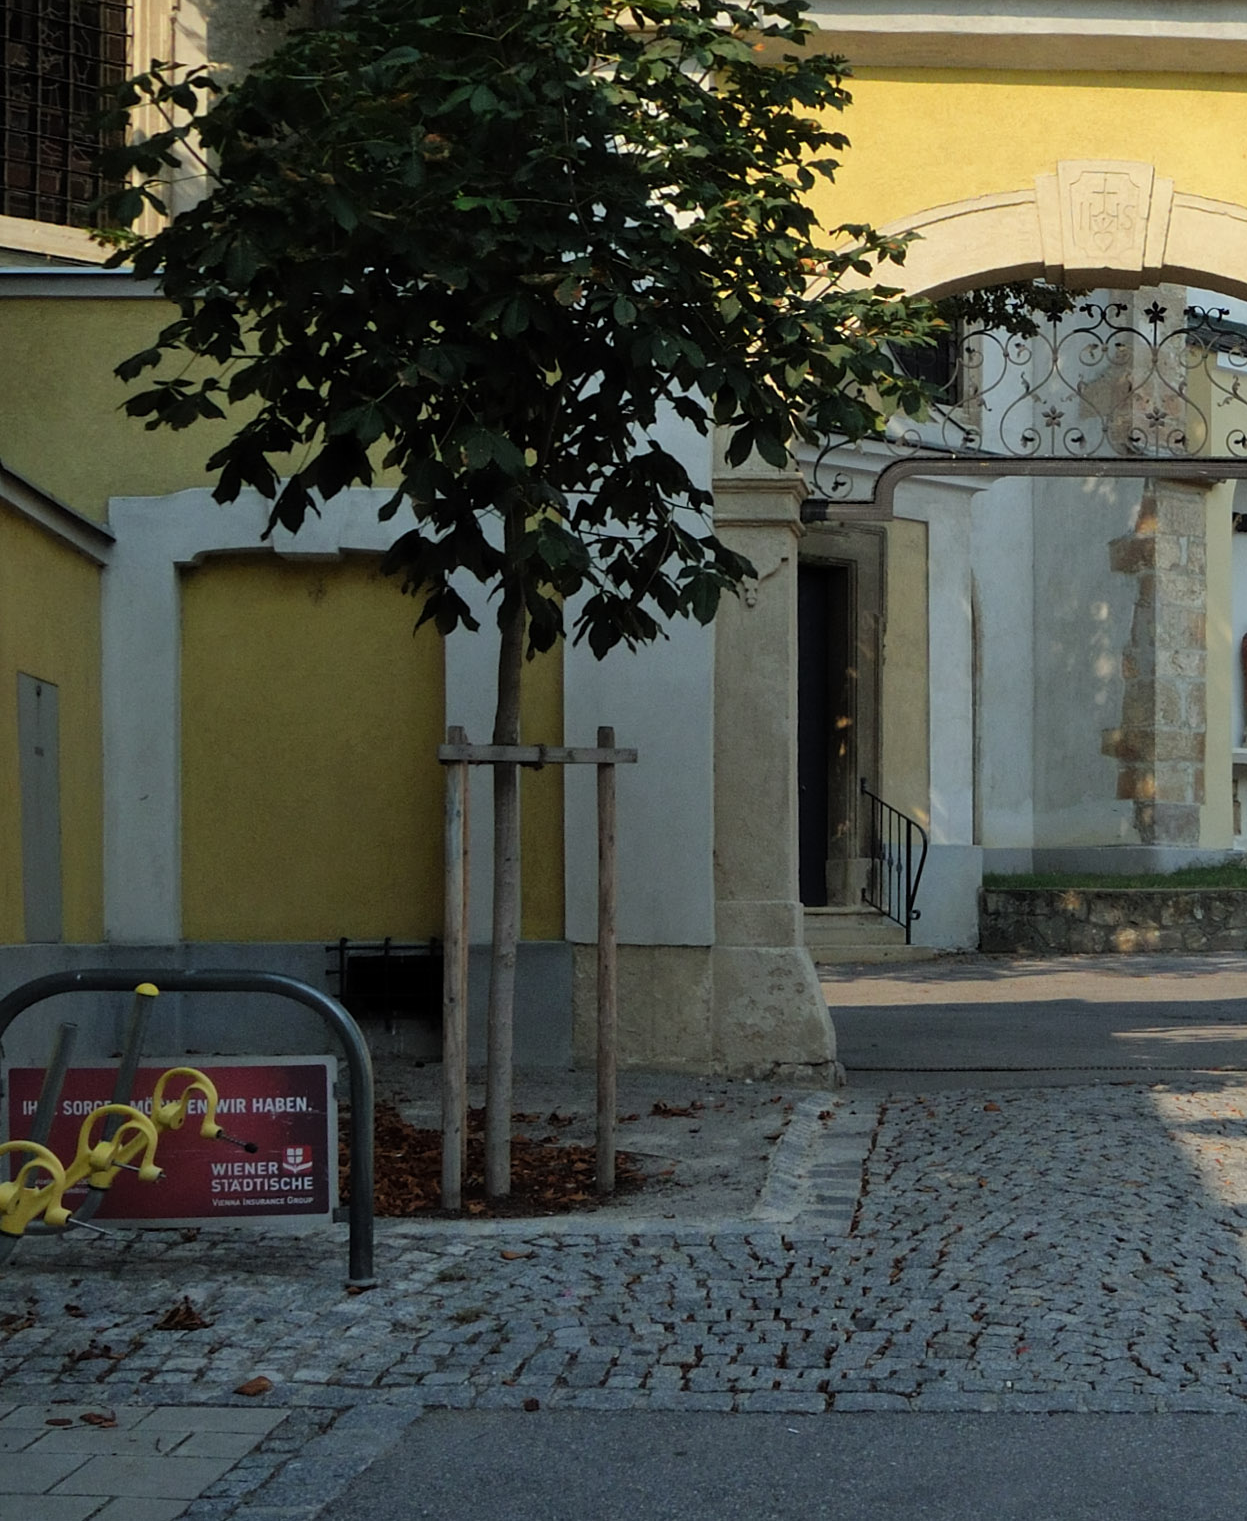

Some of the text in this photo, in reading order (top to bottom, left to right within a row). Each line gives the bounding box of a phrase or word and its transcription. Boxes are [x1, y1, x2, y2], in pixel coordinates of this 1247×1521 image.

[216, 1098, 246, 1113] WIR
[252, 1097, 313, 1113] HABEN.
[211, 1162, 278, 1176] WIENER
[211, 1177, 313, 1192] STÄDTISCHE
